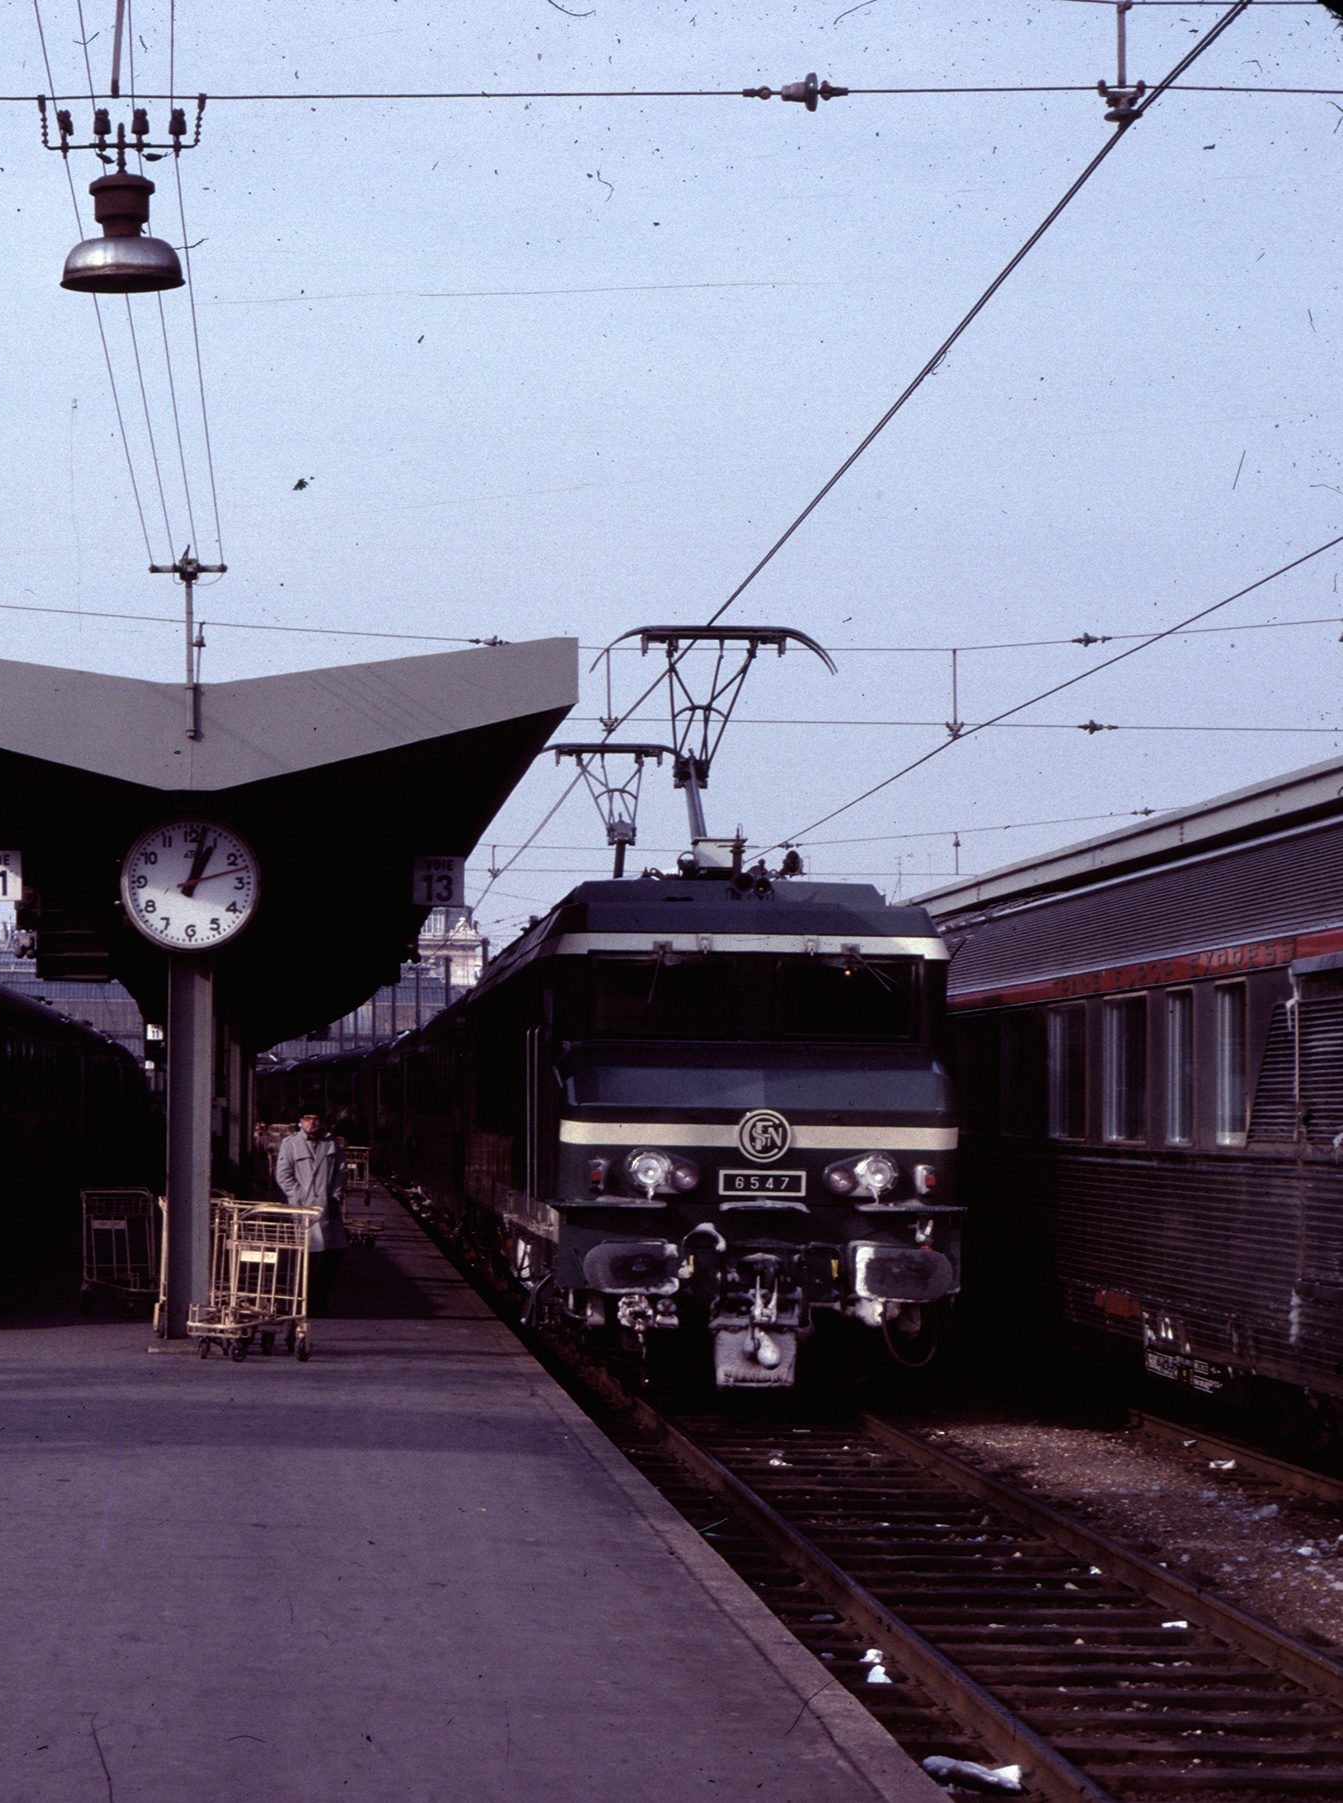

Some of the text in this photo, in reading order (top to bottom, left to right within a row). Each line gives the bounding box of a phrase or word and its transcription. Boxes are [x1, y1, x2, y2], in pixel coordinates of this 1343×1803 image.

[162, 835, 172, 848] 11
[184, 829, 200, 843] 12
[213, 837, 218, 849] 1
[143, 851, 158, 865] 10
[183, 850, 197, 858] AT
[226, 853, 239, 866] 2
[425, 859, 454, 871] VOIE
[136, 875, 148, 889] 9
[233, 877, 246, 890] 3
[422, 874, 453, 903] 13
[144, 899, 157, 913] 8
[225, 901, 239, 914] 4
[160, 917, 171, 931] 7
[185, 924, 197, 938] 6
[209, 918, 221, 931] 5
[1189, 937, 1295, 977] EXPRESS
[734, 1176, 790, 1190] 6547
